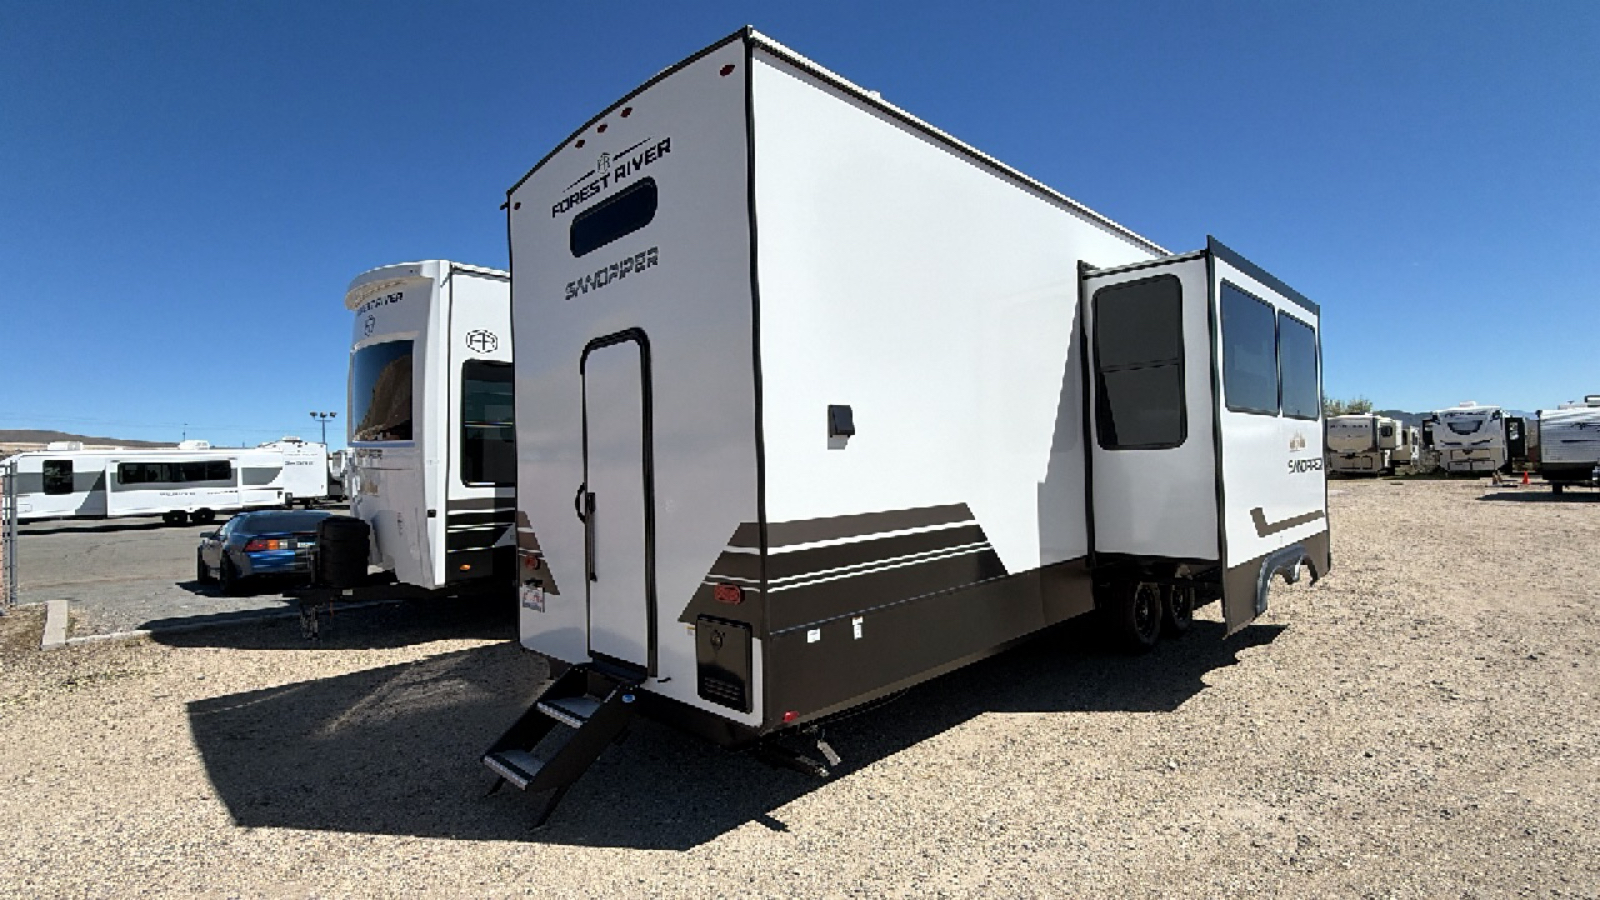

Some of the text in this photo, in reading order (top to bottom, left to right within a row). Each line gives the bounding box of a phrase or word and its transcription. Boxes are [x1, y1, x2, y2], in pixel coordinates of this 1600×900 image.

[552, 137, 671, 218] FOREST RIVER
[564, 246, 659, 301] SANDPIPER
